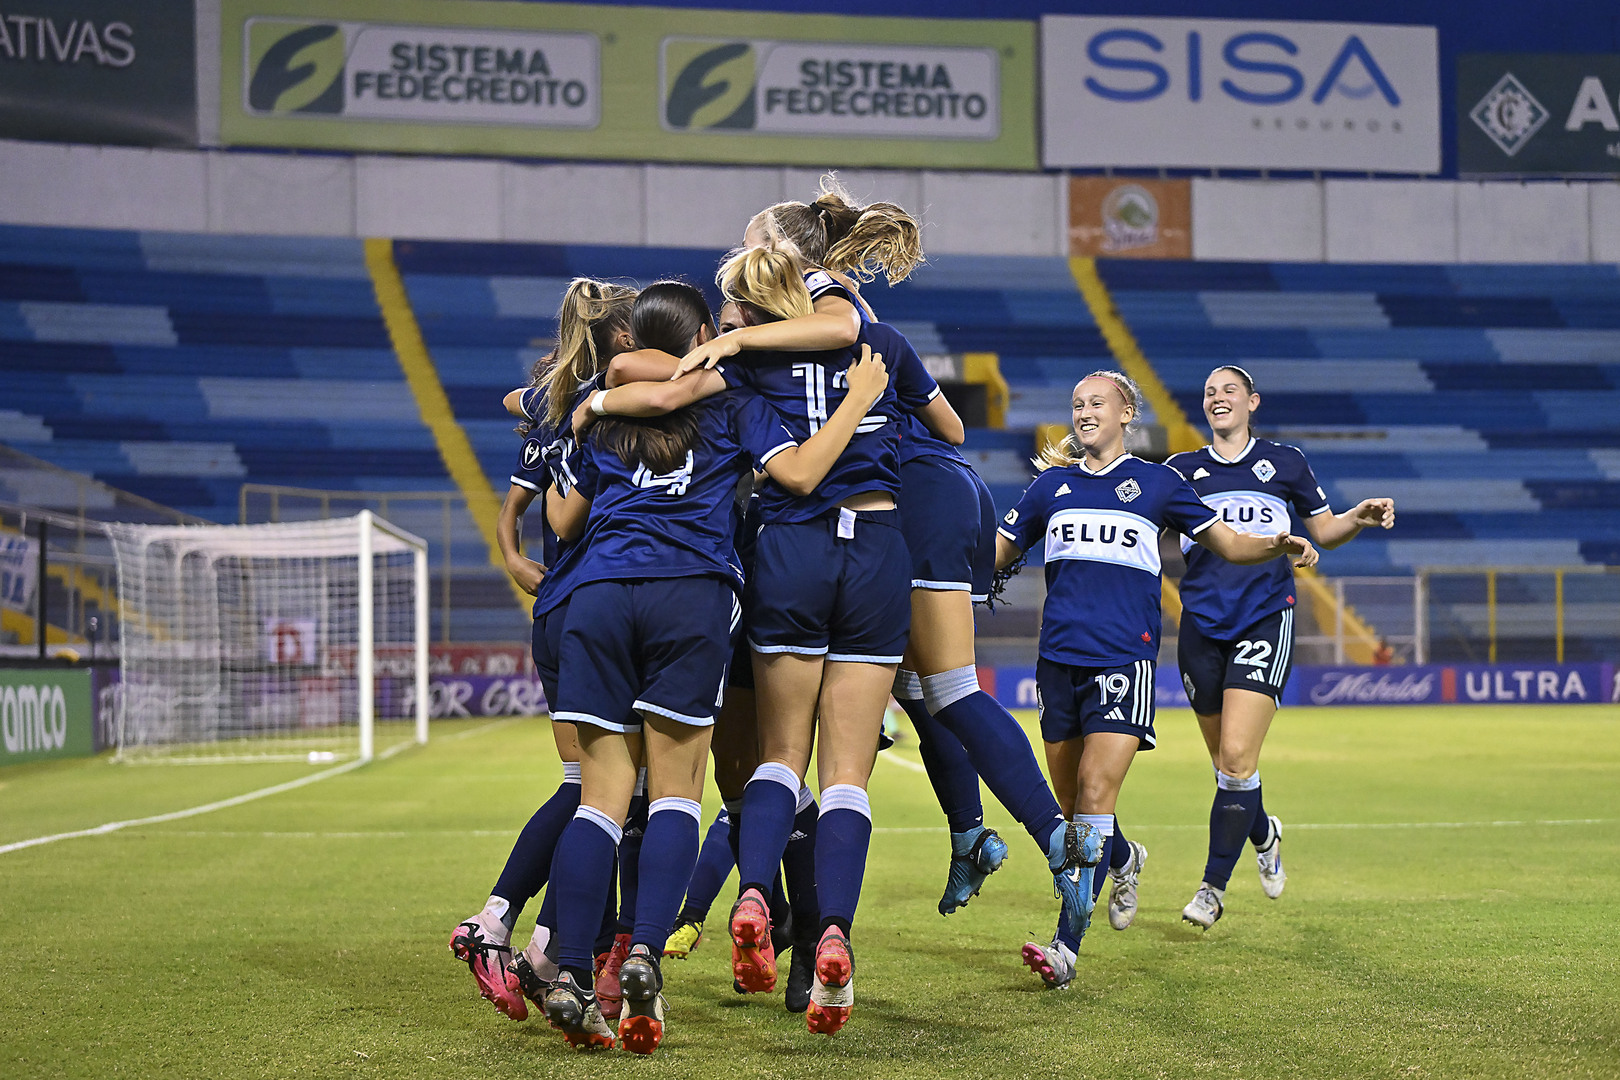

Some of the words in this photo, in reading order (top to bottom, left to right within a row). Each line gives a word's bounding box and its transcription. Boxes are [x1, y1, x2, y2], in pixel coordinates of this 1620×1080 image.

[390, 41, 551, 76] SISTEMA
[1084, 28, 1401, 107] SISA
[354, 71, 587, 108] FEDECREDITO
[801, 60, 951, 90] SISTEMA
[765, 88, 987, 120] FEDECREDITO
[1565, 76, 1620, 132] A
[1216, 507, 1274, 524] LUS
[1051, 523, 1139, 548] TELUS
[1233, 640, 1272, 668] 22
[1095, 673, 1130, 706] 19
[1465, 670, 1587, 700] ULTRA
[0, 684, 67, 752] amco
